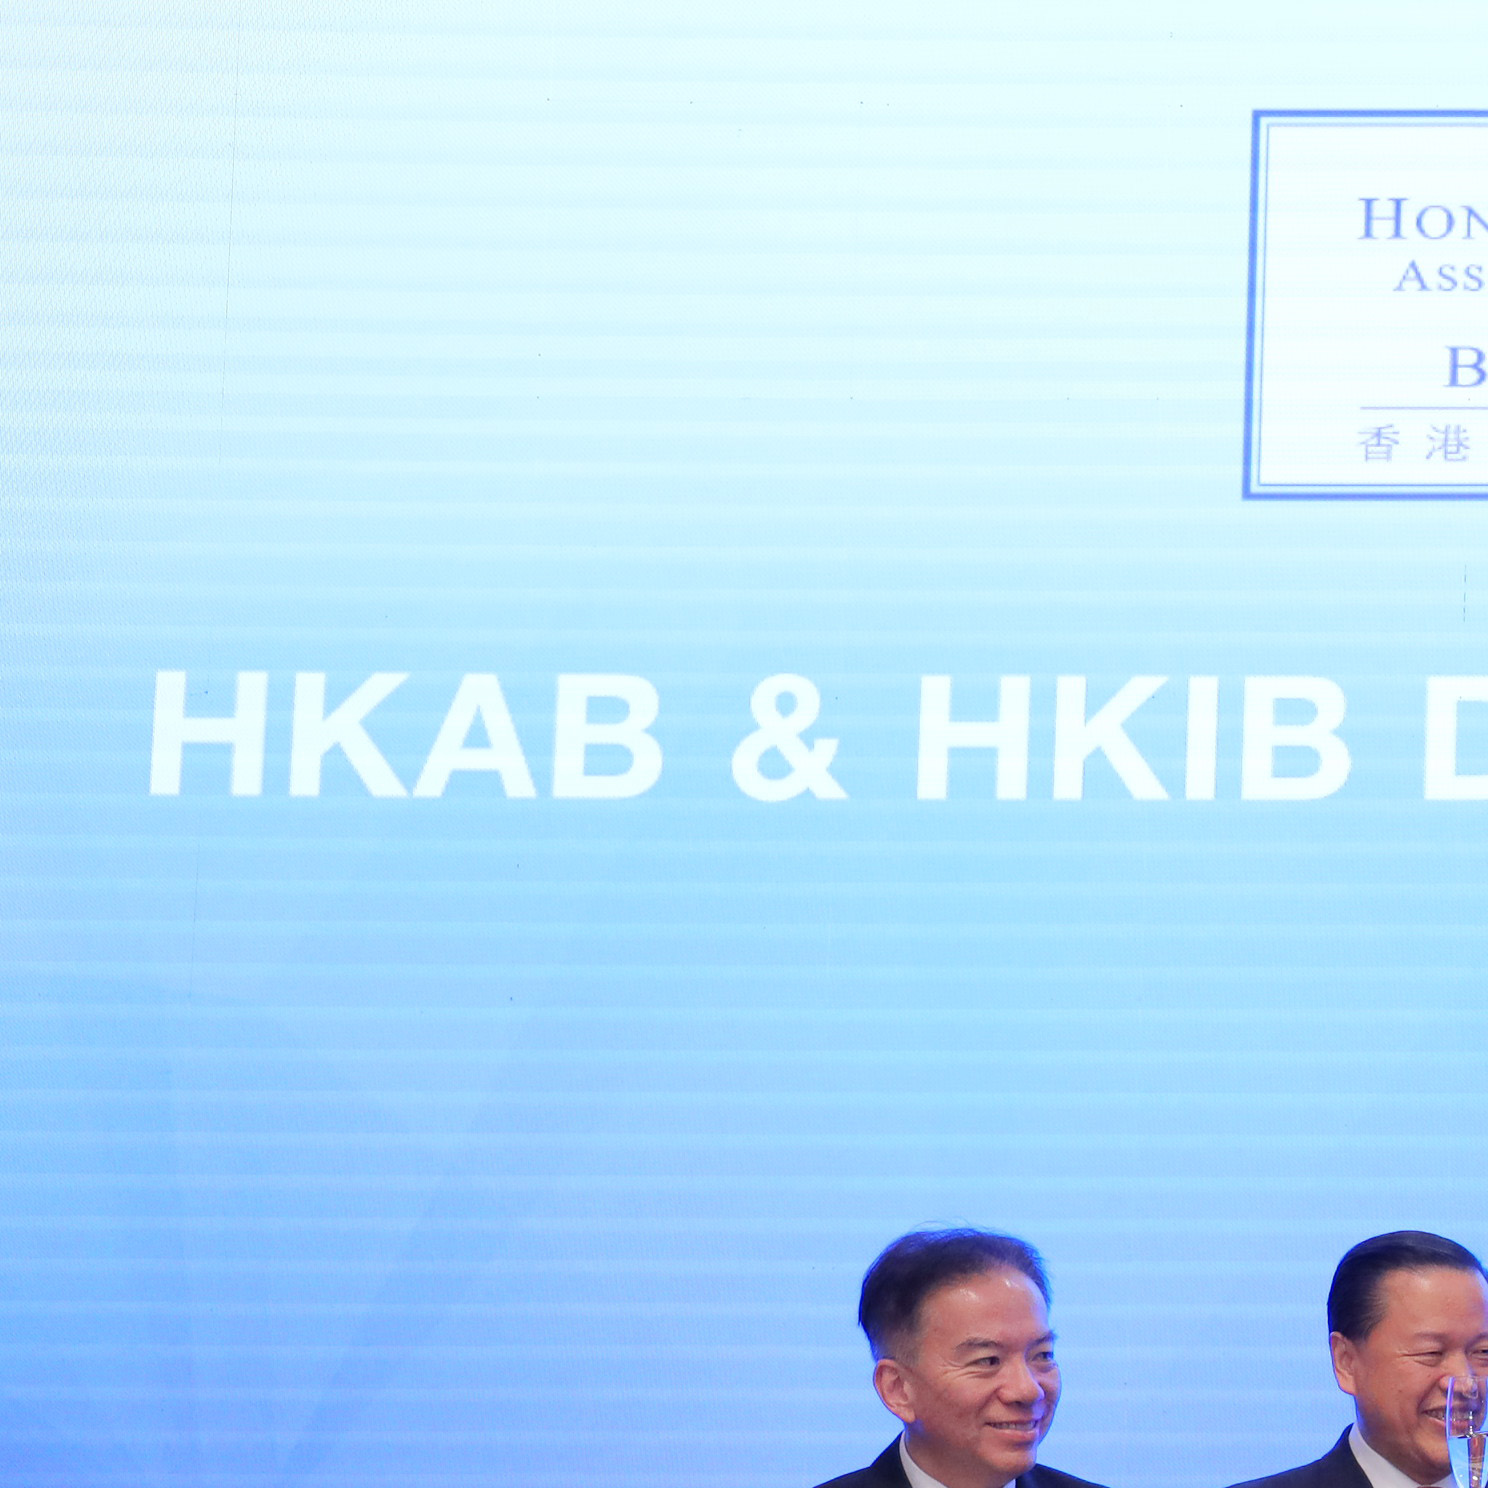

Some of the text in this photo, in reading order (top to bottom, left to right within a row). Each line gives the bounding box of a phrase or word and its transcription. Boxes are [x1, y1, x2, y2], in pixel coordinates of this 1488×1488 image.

[146, 670, 663, 802] HKAB
[732, 674, 848, 802] &
[917, 674, 1351, 801] HKIB
